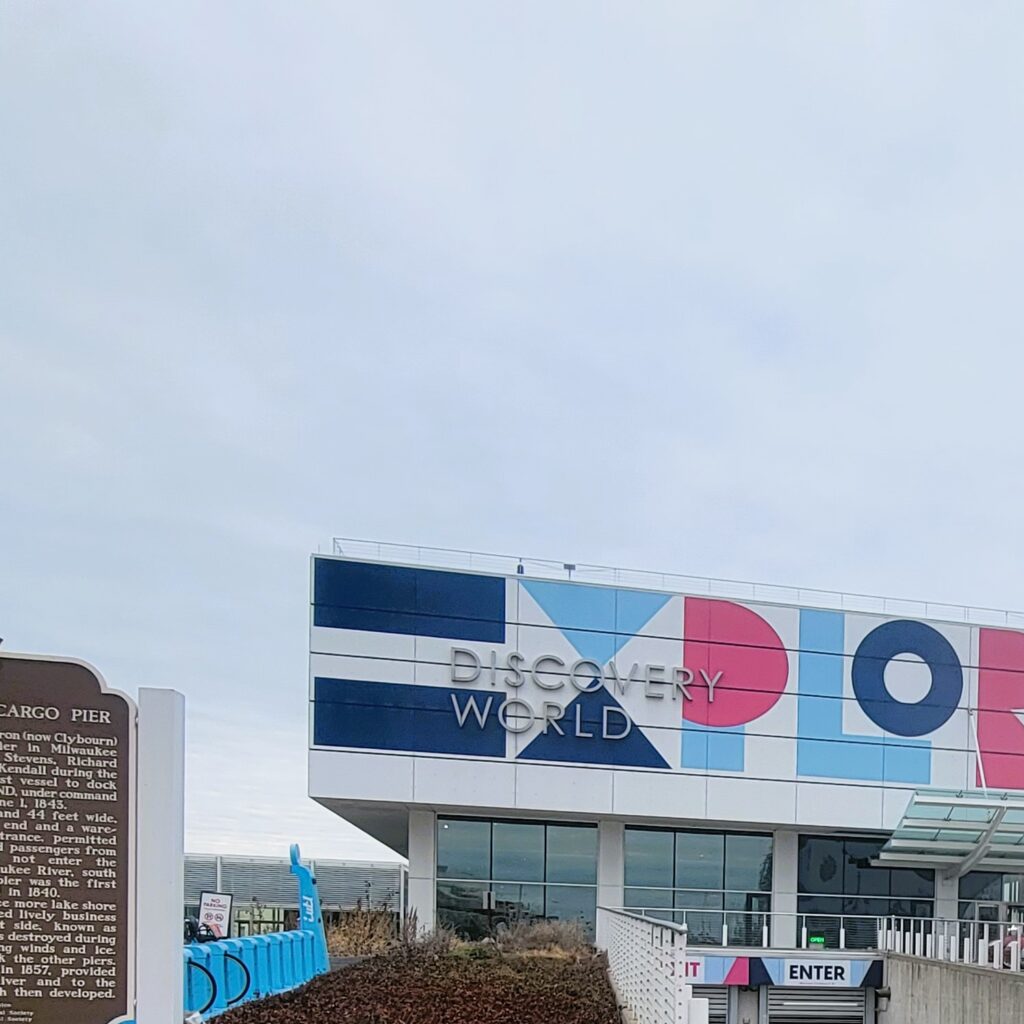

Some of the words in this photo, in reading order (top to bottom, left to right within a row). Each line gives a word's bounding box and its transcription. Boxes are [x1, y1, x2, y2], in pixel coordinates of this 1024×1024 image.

[451, 646, 723, 703] DISCOVERY
[0, 704, 60, 720] CARGO
[71, 709, 111, 723] PIER
[451, 693, 632, 740] WORLD
[23, 731, 51, 741] (now
[54, 733, 118, 746] Clybourn)
[28, 743, 40, 752] in
[51, 744, 117, 756] Milwaukee
[67, 756, 117, 768] Richard
[0, 763, 47, 775] Kendall
[51, 766, 93, 779] during
[97, 769, 117, 779] the
[20, 777, 58, 787] vessel
[66, 778, 79, 788] to
[87, 780, 117, 790] dock
[21, 788, 57, 798] under
[59, 791, 117, 801] command
[35, 799, 67, 810] 1843.
[27, 809, 45, 820] 44
[52, 811, 79, 821] feet
[3, 821, 28, 830] end
[35, 822, 59, 831] and
[53, 835, 117, 845] permitted
[10, 844, 80, 856] passengers
[85, 846, 117, 856] from
[13, 855, 36, 864] not
[48, 857, 82, 866] enter
[96, 858, 117, 867] the
[82, 868, 117, 878] south
[29, 878, 52, 886] was
[58, 878, 80, 887] the
[87, 879, 117, 889] first
[8, 887, 21, 897] in
[28, 887, 61, 898] 1840.
[14, 900, 48, 909] more
[51, 900, 79, 910] lake
[82, 901, 117, 911] shore
[20, 910, 56, 922] lively
[63, 911, 117, 922] business
[54, 922, 95, 932] known
[8, 932, 71, 943] destroyed
[75, 933, 117, 946] during
[20, 944, 55, 953] winds
[63, 945, 86, 954] and
[14, 954, 34, 964] the
[41, 955, 76, 965] other
[1, 965, 13, 975] in
[61, 967, 117, 978] provided
[789, 965, 845, 980] ENTER
[37, 977, 61, 987] and
[72, 978, 85, 987] to
[96, 978, 117, 988] the
[14, 987, 43, 997] then
[49, 988, 116, 1000] developed.
